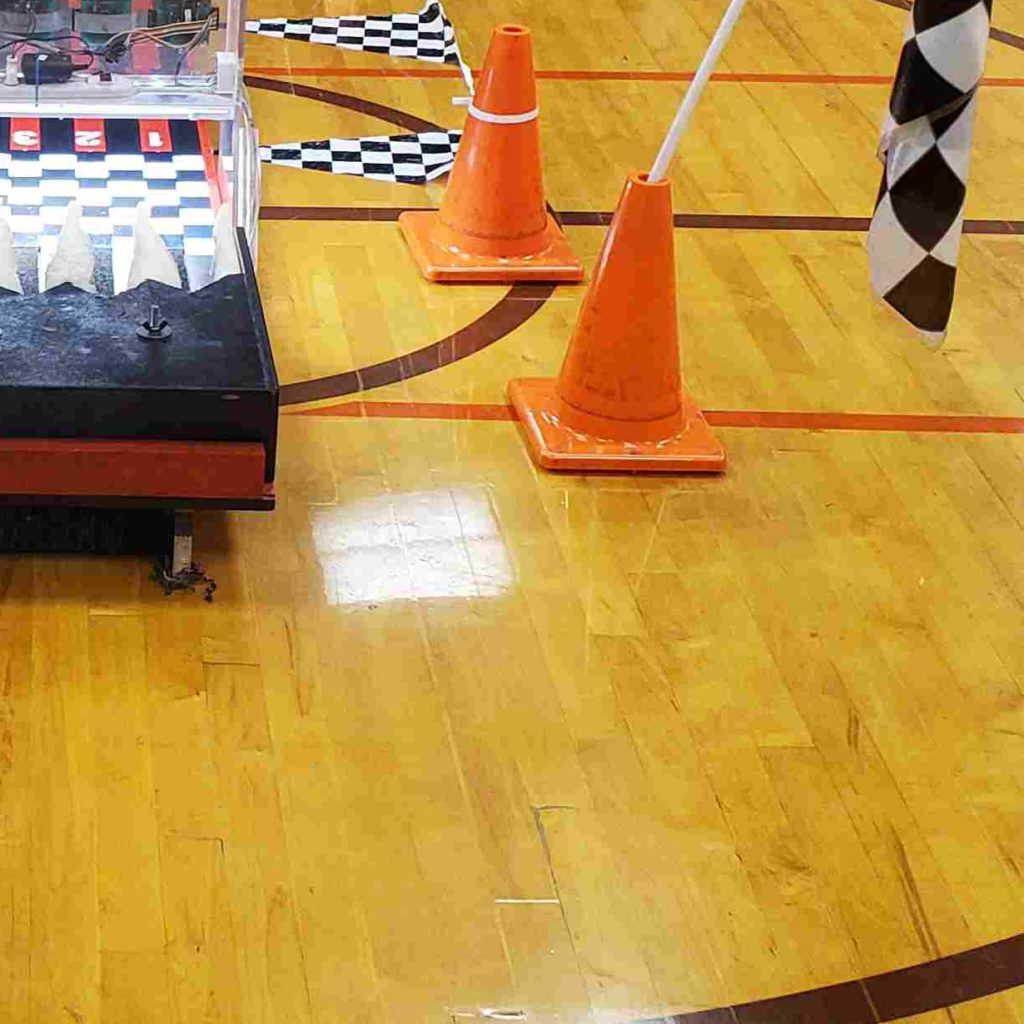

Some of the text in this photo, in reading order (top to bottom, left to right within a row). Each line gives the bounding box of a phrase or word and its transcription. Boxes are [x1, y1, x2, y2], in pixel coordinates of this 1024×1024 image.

[12, 130, 39, 146] 3
[74, 130, 102, 147] 2
[147, 131, 164, 148] 1
